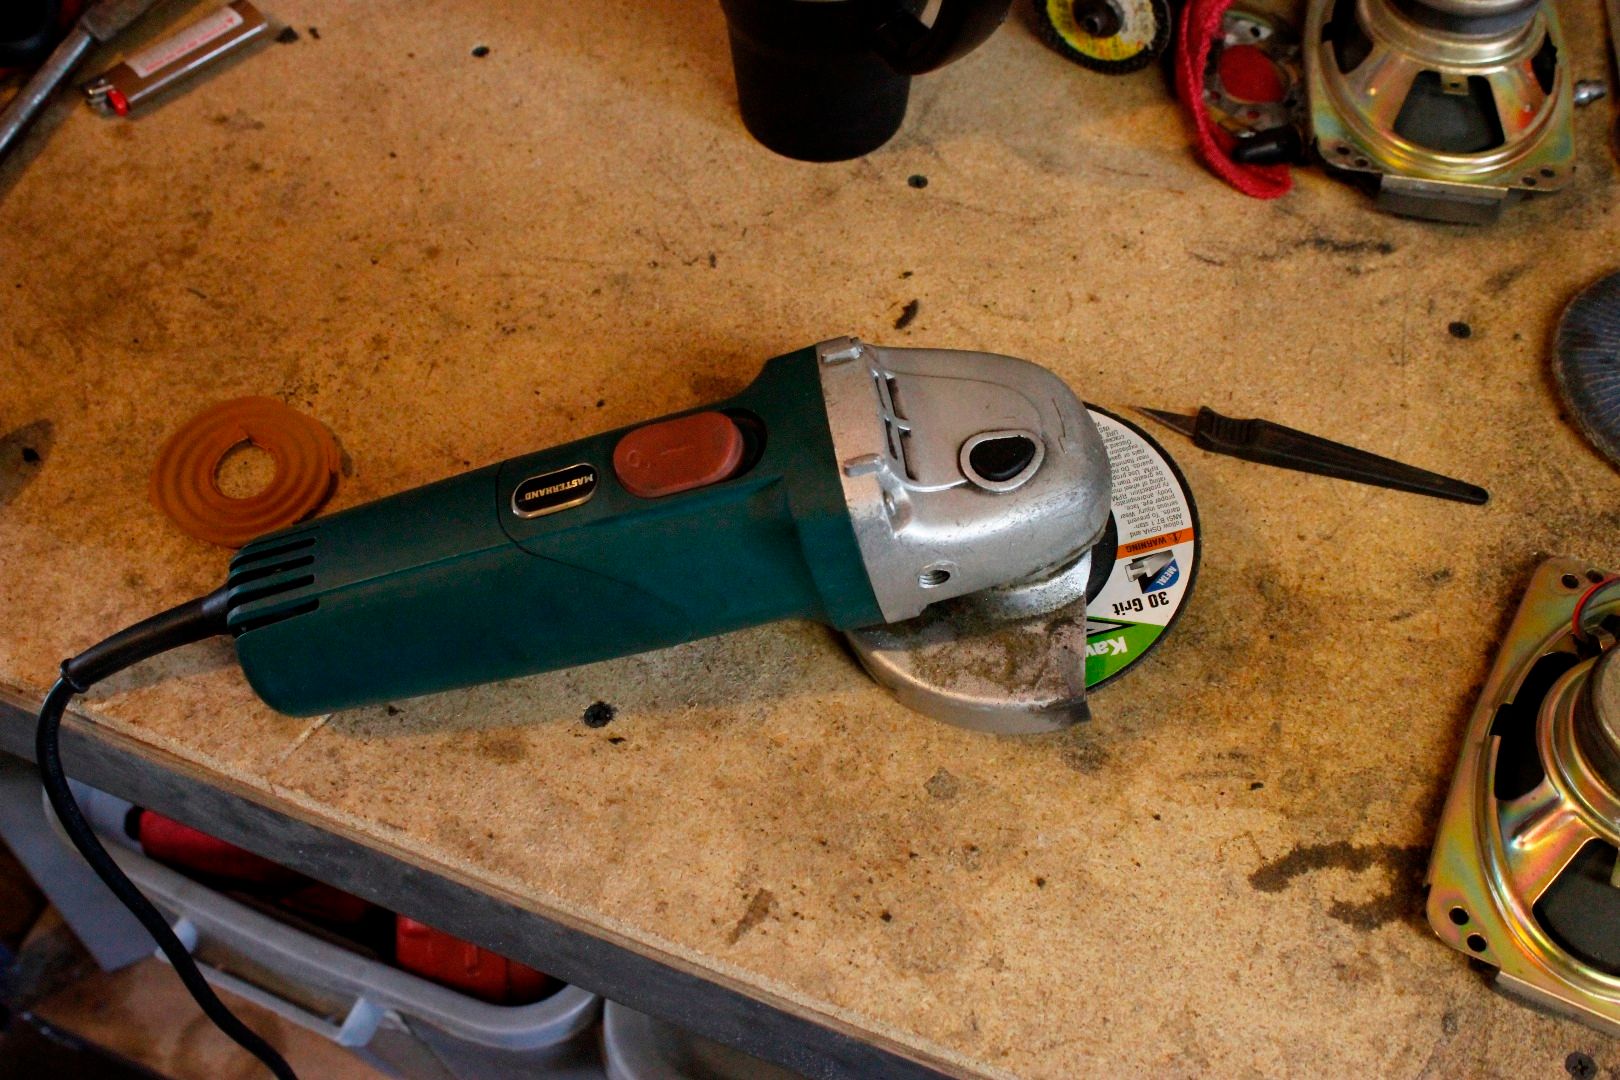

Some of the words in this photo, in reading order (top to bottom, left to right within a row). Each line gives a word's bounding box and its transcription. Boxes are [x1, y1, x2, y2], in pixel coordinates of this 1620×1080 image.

[1111, 459, 1134, 468] flamma
[1112, 472, 1126, 480] prop
[1133, 472, 1153, 482] greater
[524, 473, 594, 500] MASTERHAND
[1124, 483, 1140, 491] wheel
[1156, 493, 1175, 503] proper
[1157, 501, 1178, 509] serious
[1127, 514, 1150, 524] prevent
[1167, 513, 1182, 521] ANSI
[1163, 520, 1183, 528] Follow
[1143, 526, 1161, 534] OSHA
[1125, 537, 1166, 553] WARNING
[1155, 566, 1176, 586] METAL
[1147, 592, 1169, 608] 30
[1112, 598, 1143, 616] Grit
